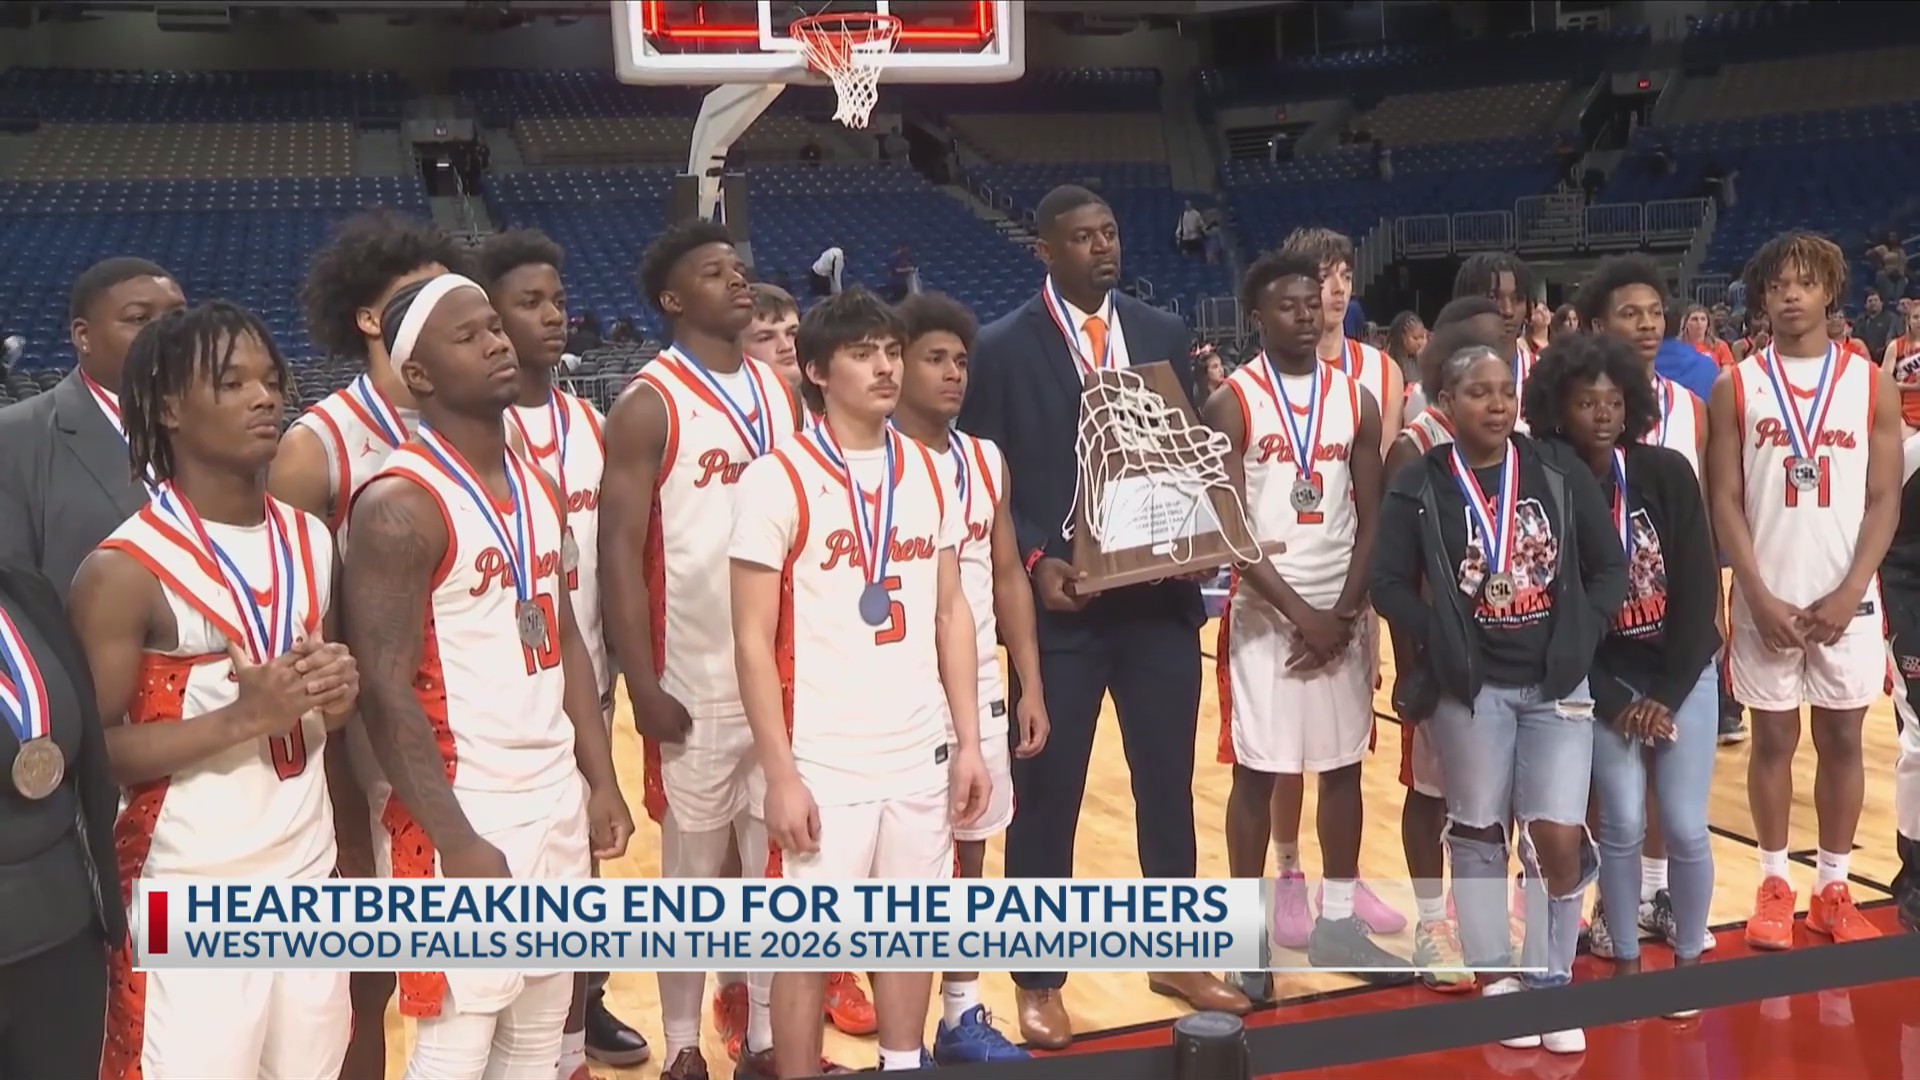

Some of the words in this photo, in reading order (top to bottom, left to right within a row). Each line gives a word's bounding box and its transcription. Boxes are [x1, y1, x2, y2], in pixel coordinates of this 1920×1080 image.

[1256, 433, 1350, 465] Paers
[1755, 417, 1856, 450] Paers
[820, 526, 936, 571] Pahers
[872, 575, 907, 647] 5
